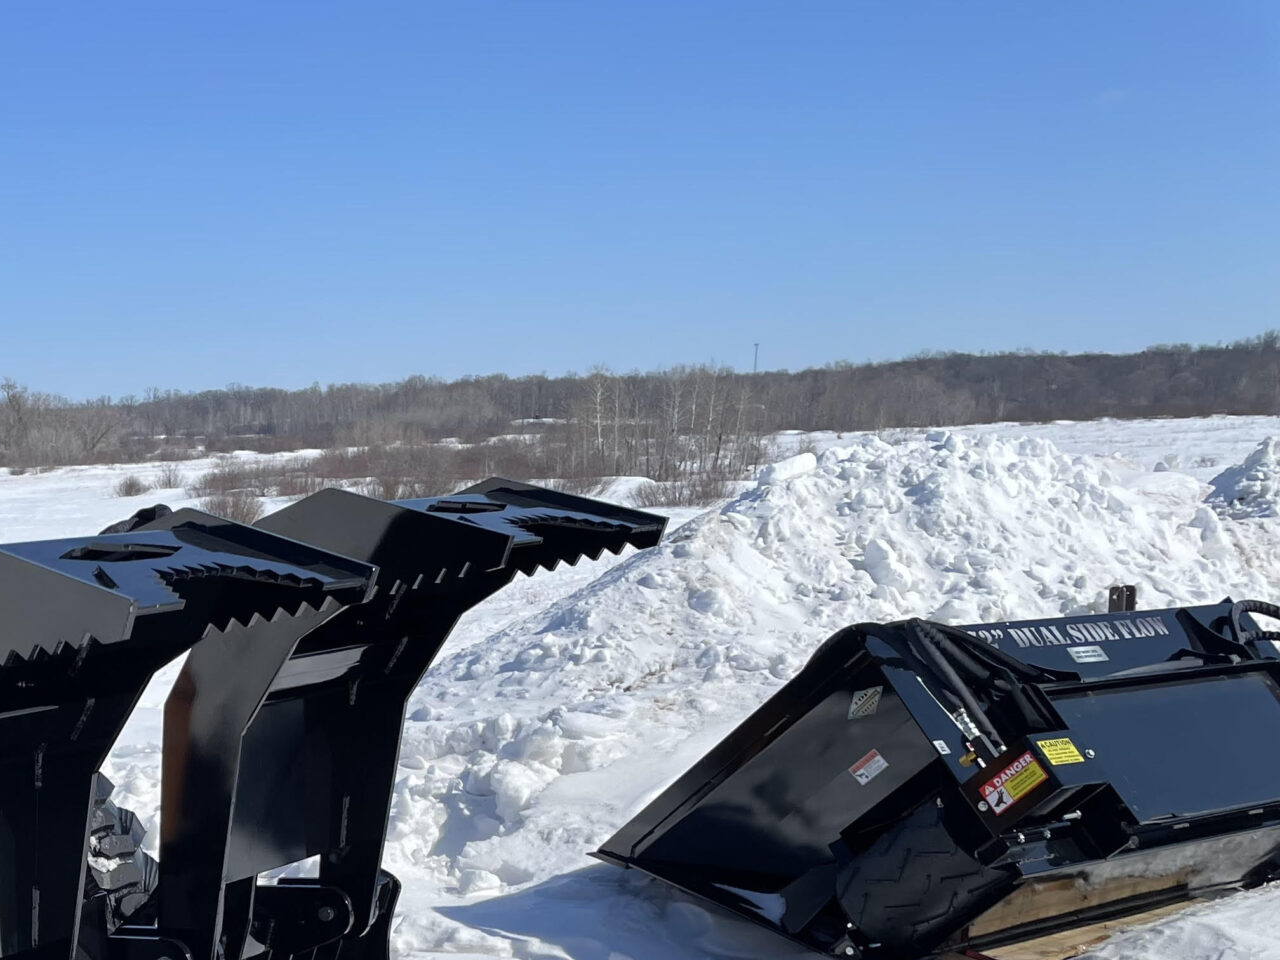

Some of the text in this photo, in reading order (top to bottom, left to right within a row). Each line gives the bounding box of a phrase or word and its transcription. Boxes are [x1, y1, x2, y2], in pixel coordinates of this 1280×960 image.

[1007, 626, 1070, 648] DUAL
[1067, 621, 1120, 643] SIDE
[1114, 616, 1169, 639] FLOW
[1043, 739, 1072, 748] CAUTION
[993, 754, 1033, 786] DANGER
